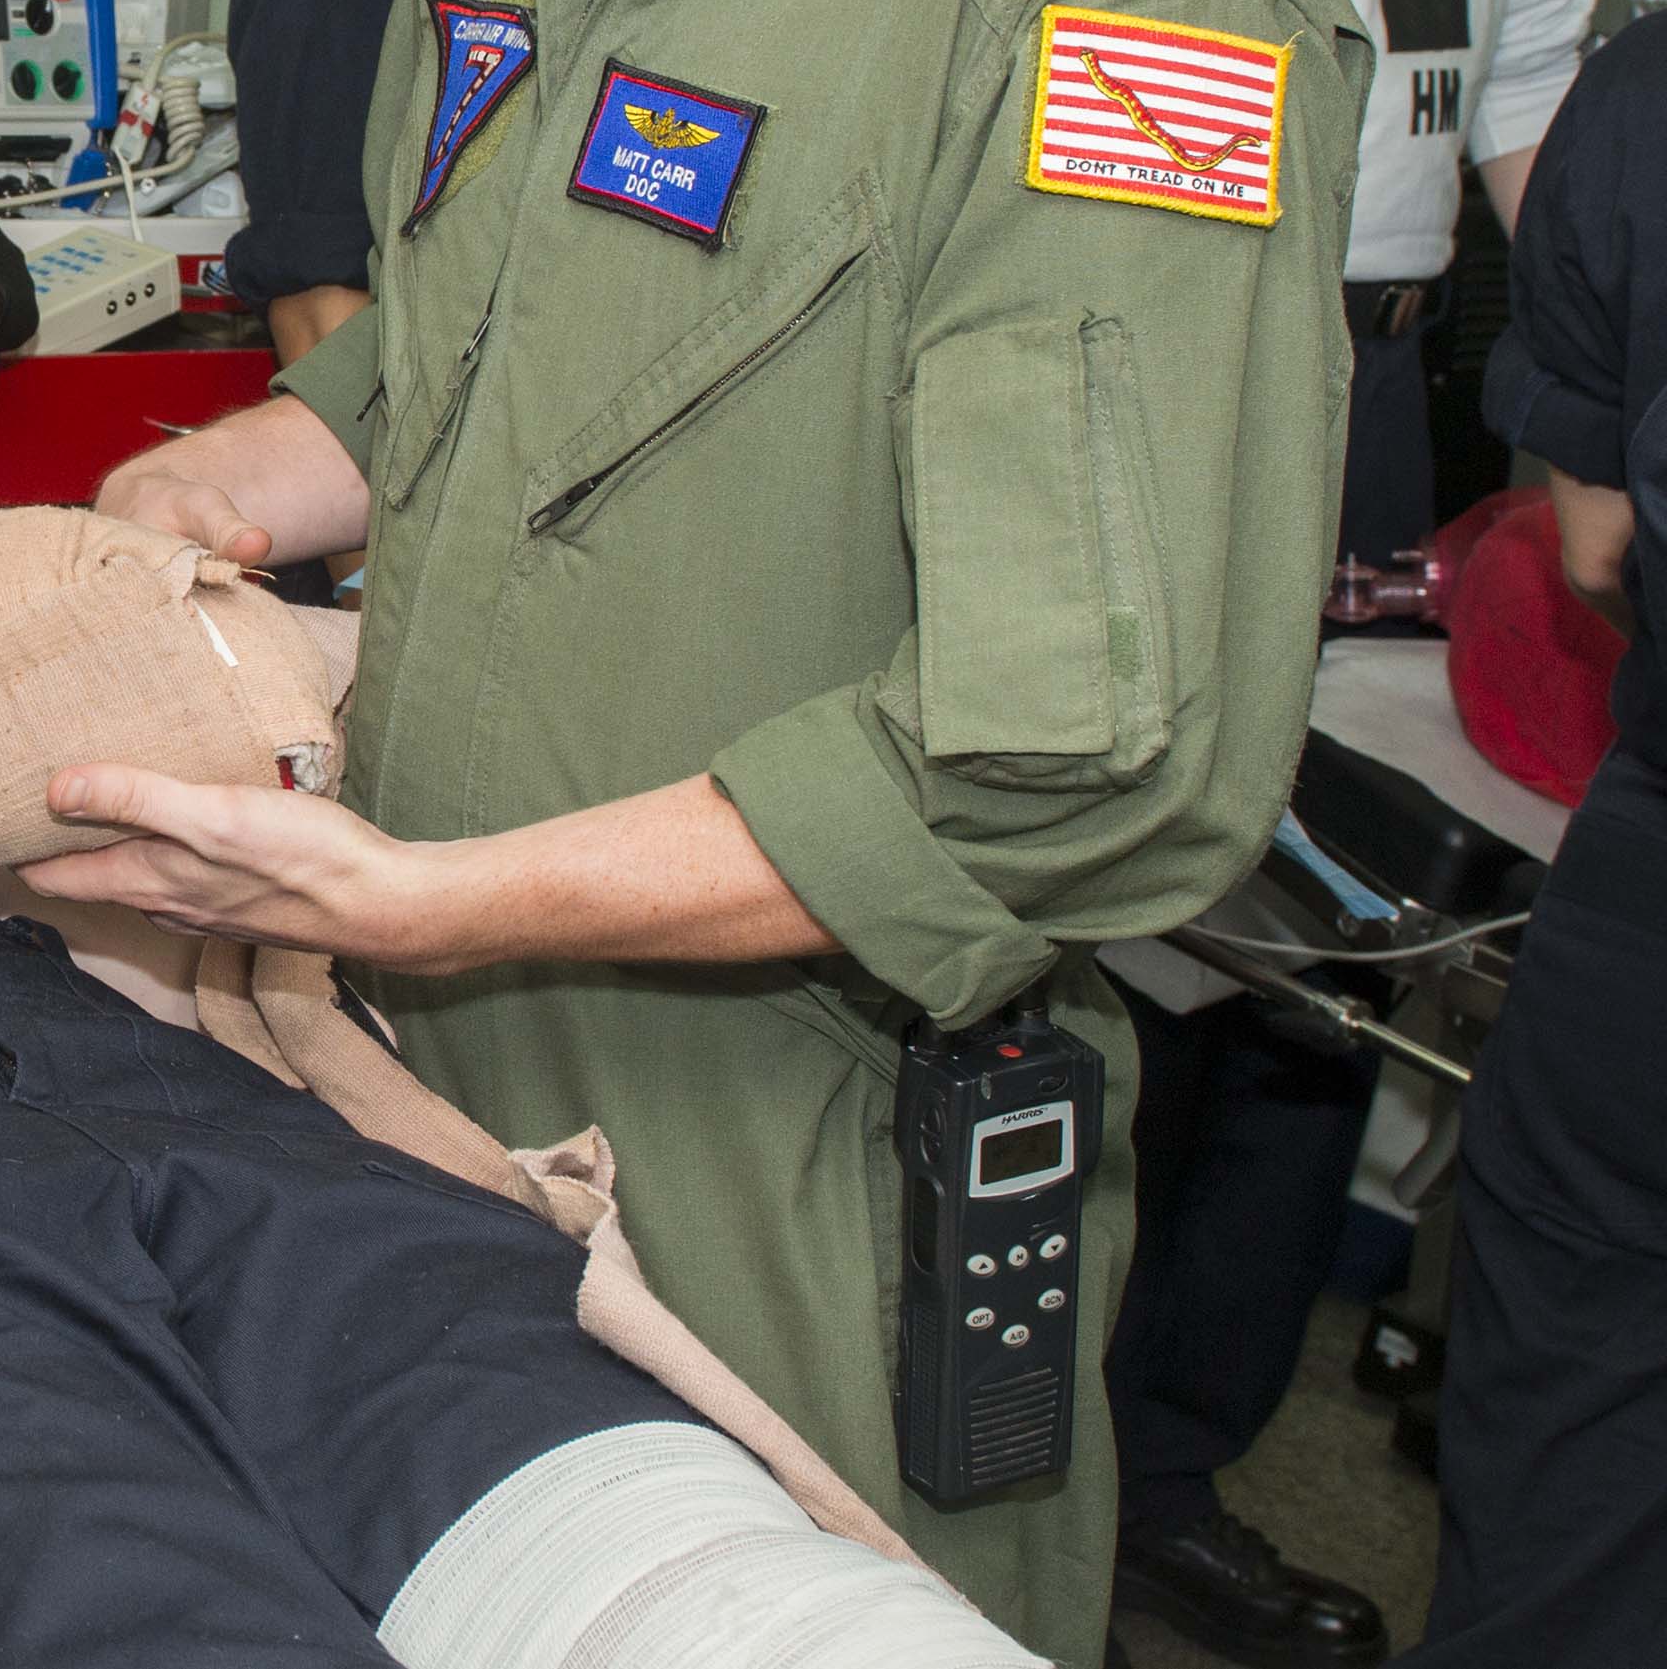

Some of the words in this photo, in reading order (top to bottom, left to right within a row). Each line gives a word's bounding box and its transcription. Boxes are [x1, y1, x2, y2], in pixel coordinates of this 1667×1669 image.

[612, 145, 650, 174] MATT
[651, 159, 696, 191] CARR
[1065, 158, 1117, 176] DONT
[1127, 166, 1183, 187] TREAD
[1192, 178, 1215, 193] ON
[1222, 183, 1244, 198] ME
[624, 174, 661, 202] DOC
[1001, 1108, 1044, 1125] HARRIS
[1044, 1295, 1062, 1306] SCN
[971, 1313, 991, 1325] OPT
